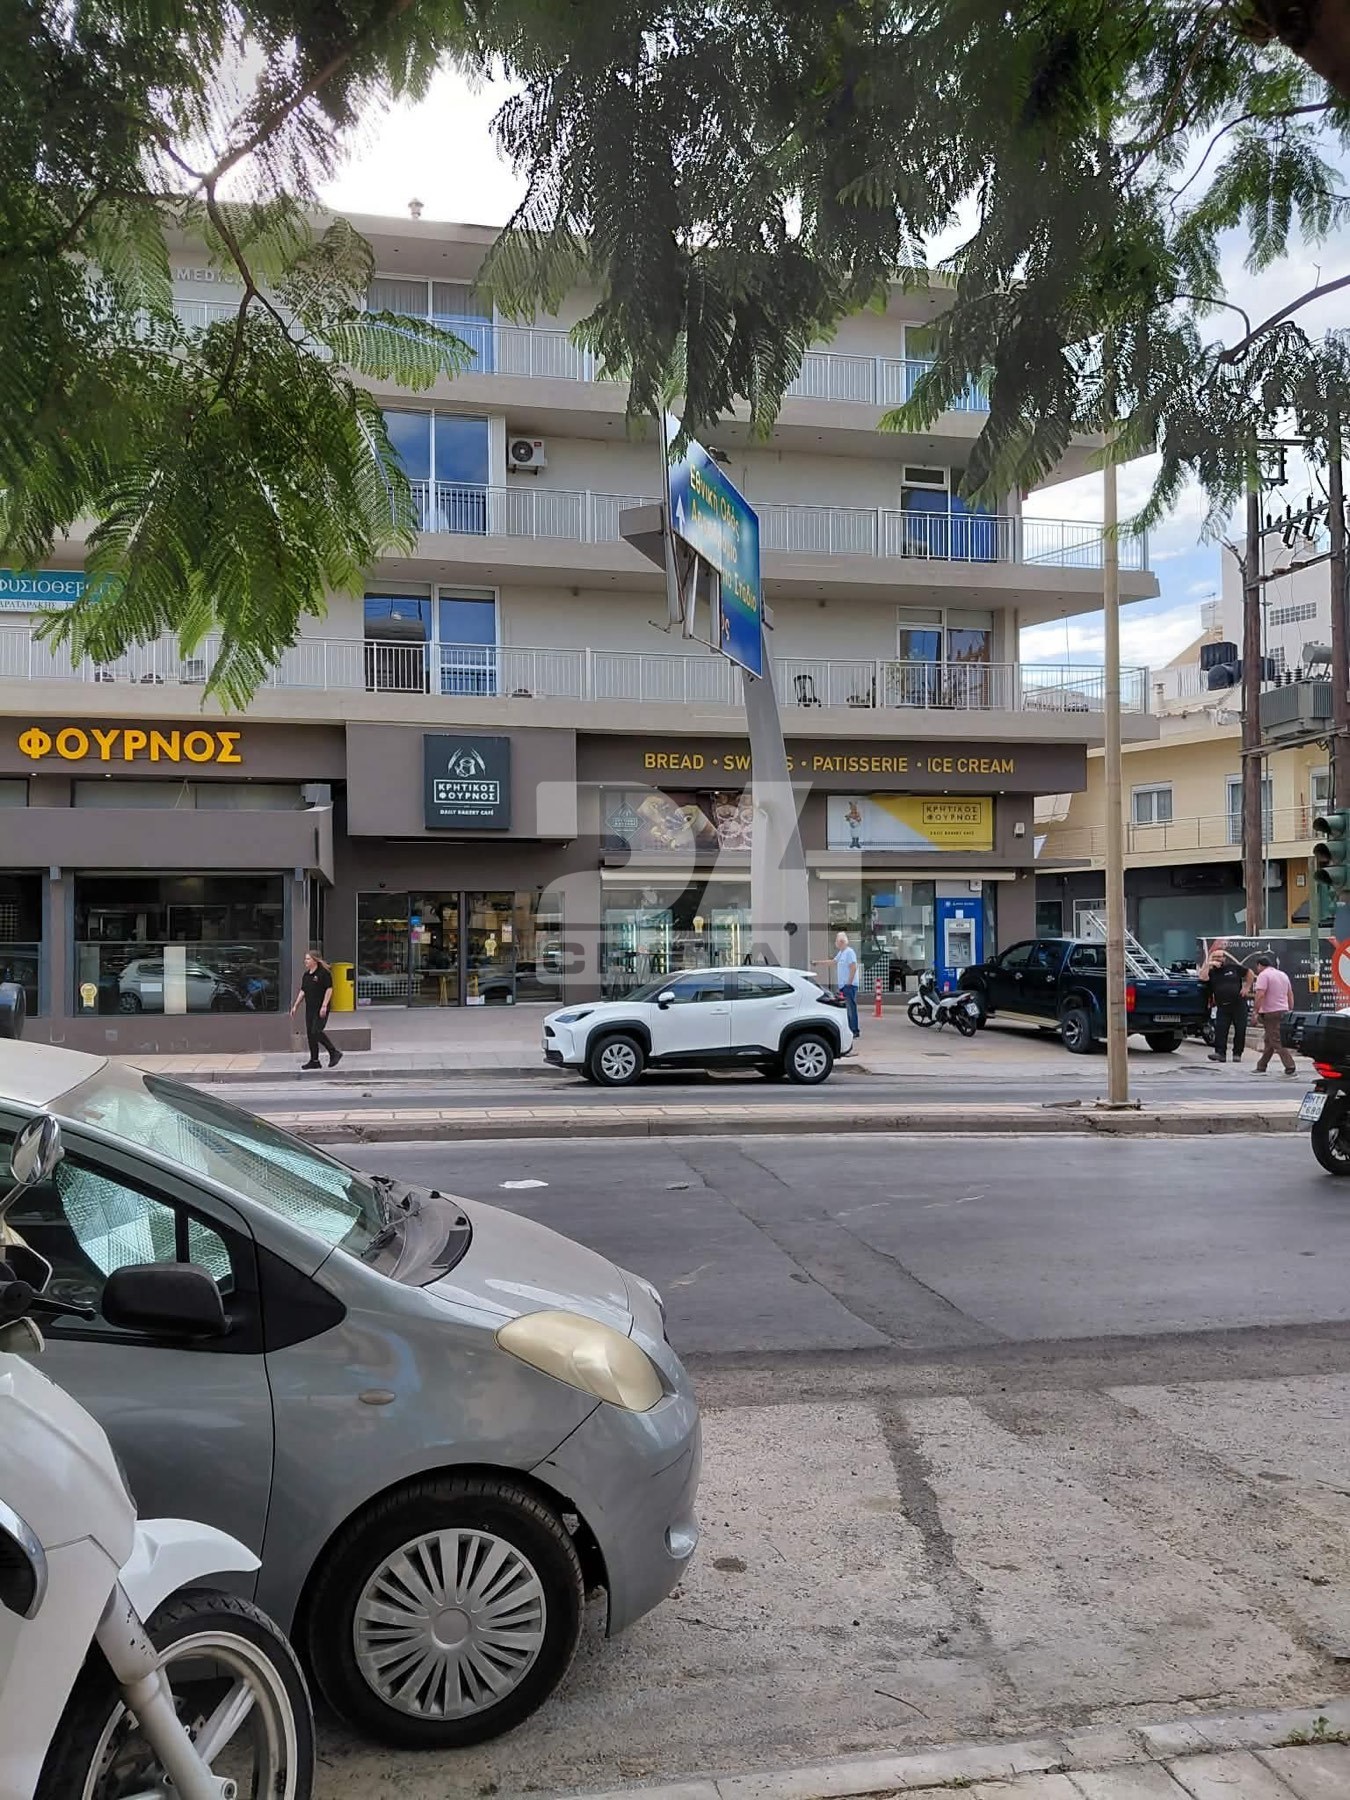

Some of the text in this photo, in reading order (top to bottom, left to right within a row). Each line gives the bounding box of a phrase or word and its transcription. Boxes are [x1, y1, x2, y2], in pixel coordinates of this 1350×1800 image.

[18, 727, 242, 763] ΦΟΥΡΝΟΣ
[644, 752, 1014, 774] BREAD SWS PATISSERIE ICE CREAM
[438, 783, 495, 792] ΚΡΗΤΙΚΟΣ
[438, 791, 495, 801] ΦΟΥΡΝΟΣ
[926, 805, 978, 813] ΚΡΗΤΙΚΟΣ
